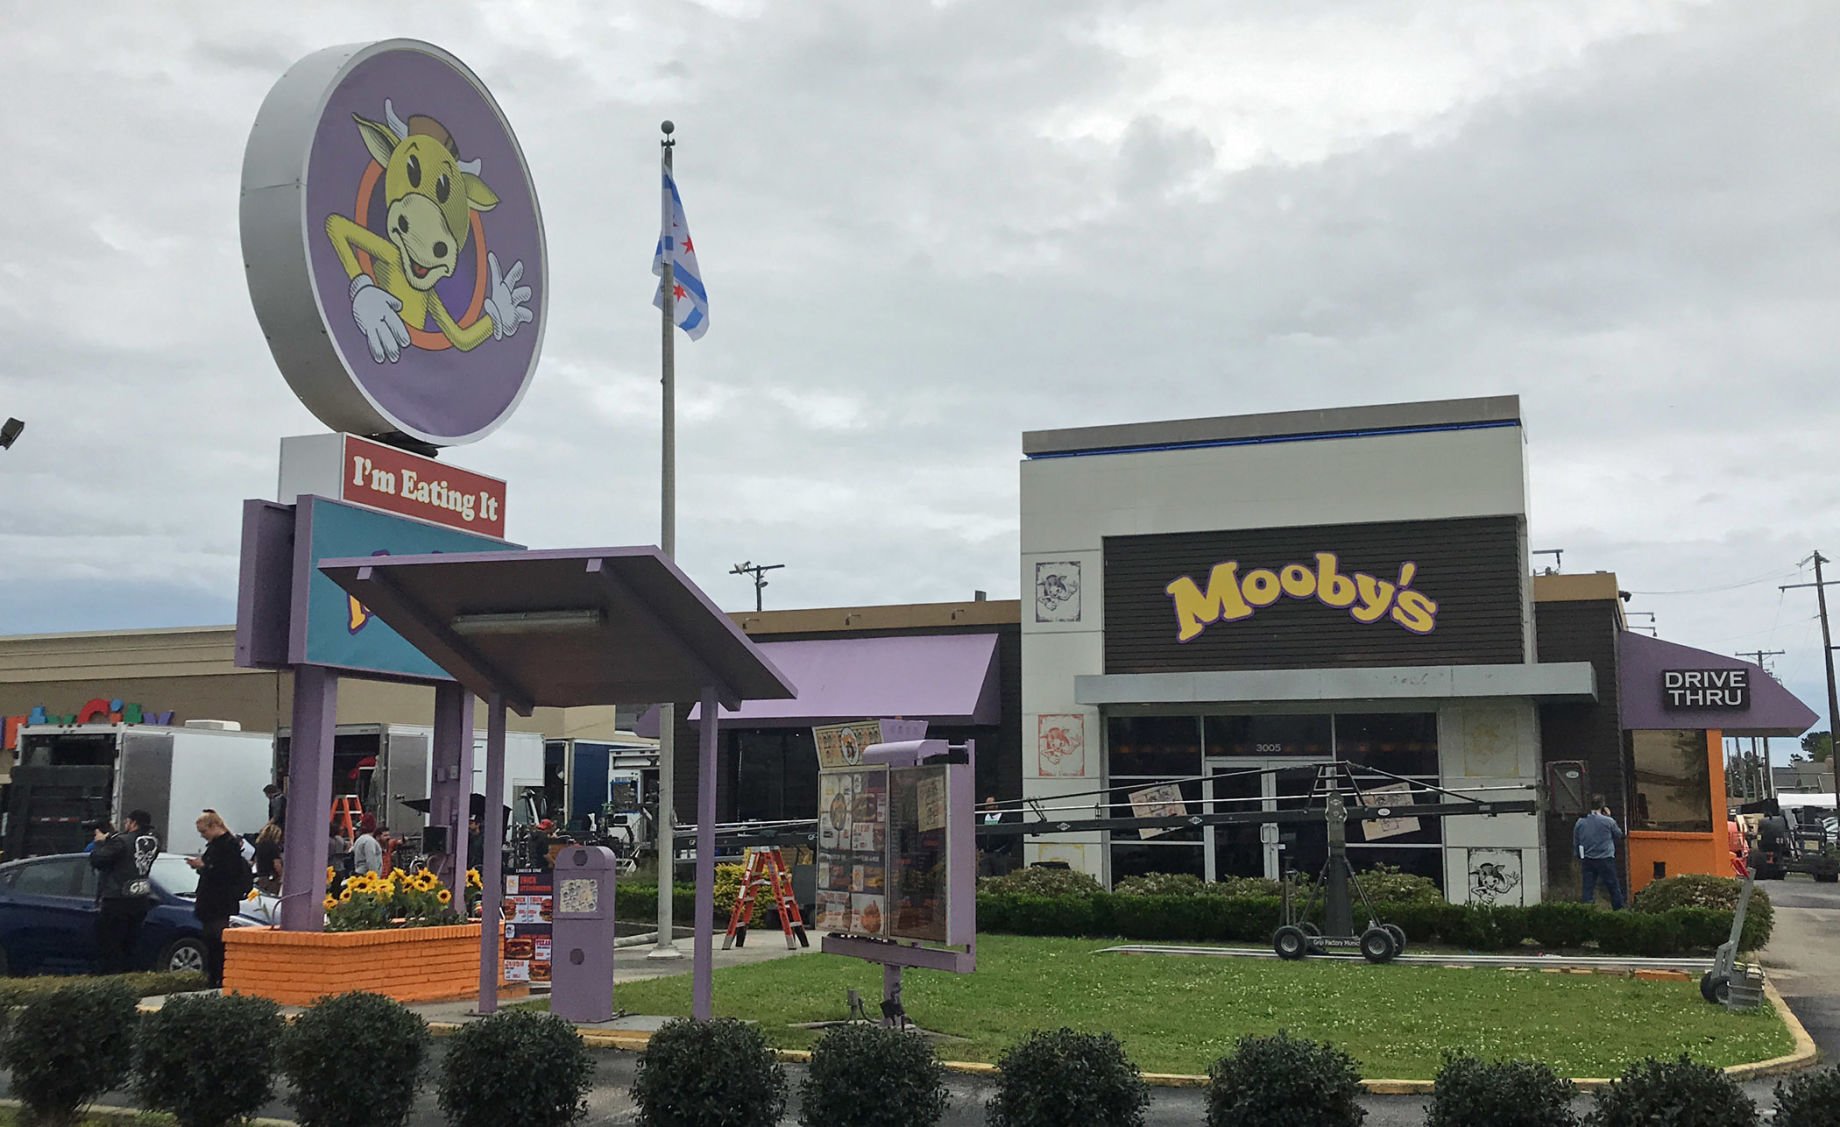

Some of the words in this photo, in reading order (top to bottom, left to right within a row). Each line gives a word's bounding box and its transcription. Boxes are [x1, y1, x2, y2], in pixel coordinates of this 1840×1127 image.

[353, 456, 396, 494] I'm
[401, 469, 475, 521] Eating
[480, 492, 498, 521] It
[1166, 552, 1438, 641] Mooby's
[1665, 671, 1746, 687] DRIVE
[1668, 689, 1742, 706] THRU
[1256, 743, 1281, 752] 3005
